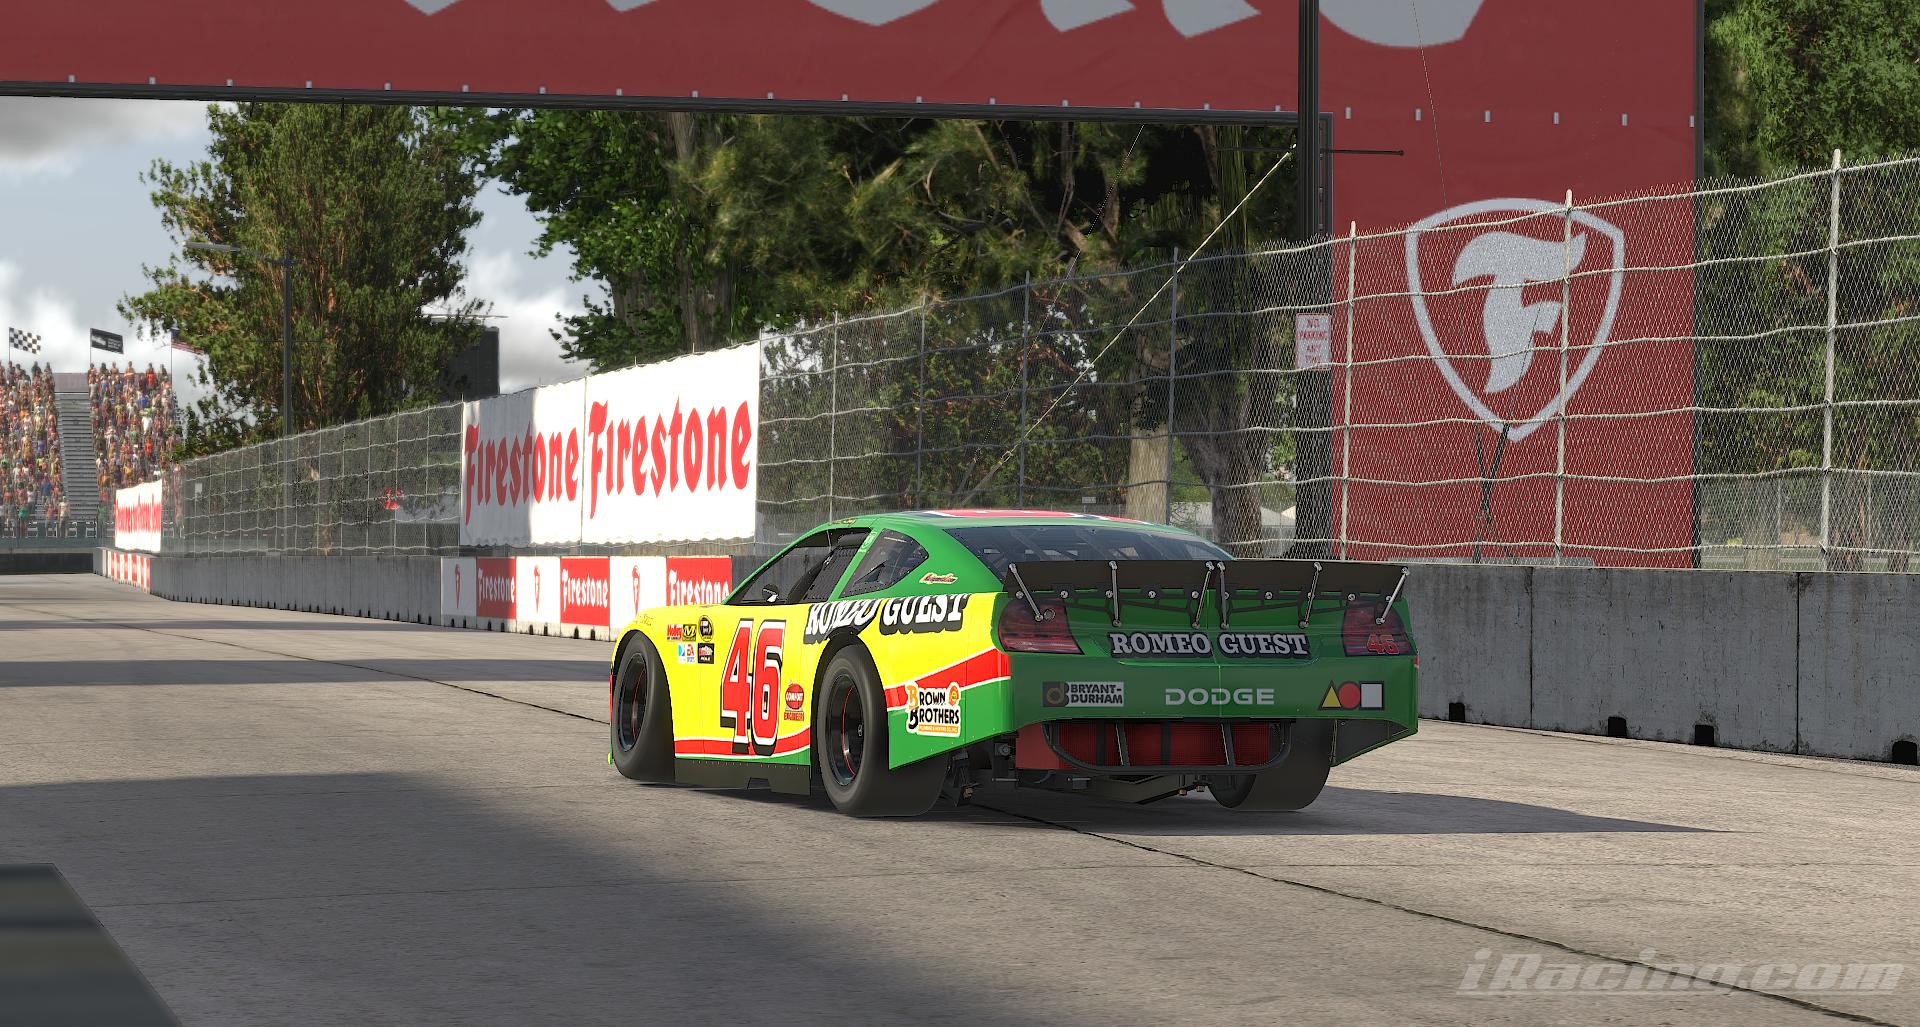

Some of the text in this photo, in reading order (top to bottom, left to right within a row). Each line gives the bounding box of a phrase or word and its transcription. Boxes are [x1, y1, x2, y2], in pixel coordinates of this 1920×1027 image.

[588, 396, 752, 520] Firestone
[464, 421, 579, 527] Firestone
[477, 567, 515, 610] Firestone
[562, 568, 609, 612] Firestone
[804, 593, 969, 642] ROMEO GUEST
[1111, 632, 1310, 656] ROMEO GUEST
[1366, 633, 1400, 655] 46
[720, 617, 787, 757] 46
[906, 685, 946, 709] BROWN
[1070, 684, 1122, 694] BRYANT-
[1070, 694, 1123, 704] DURHAM
[1164, 687, 1275, 705] DODGE
[908, 706, 960, 729] BROTHERS
